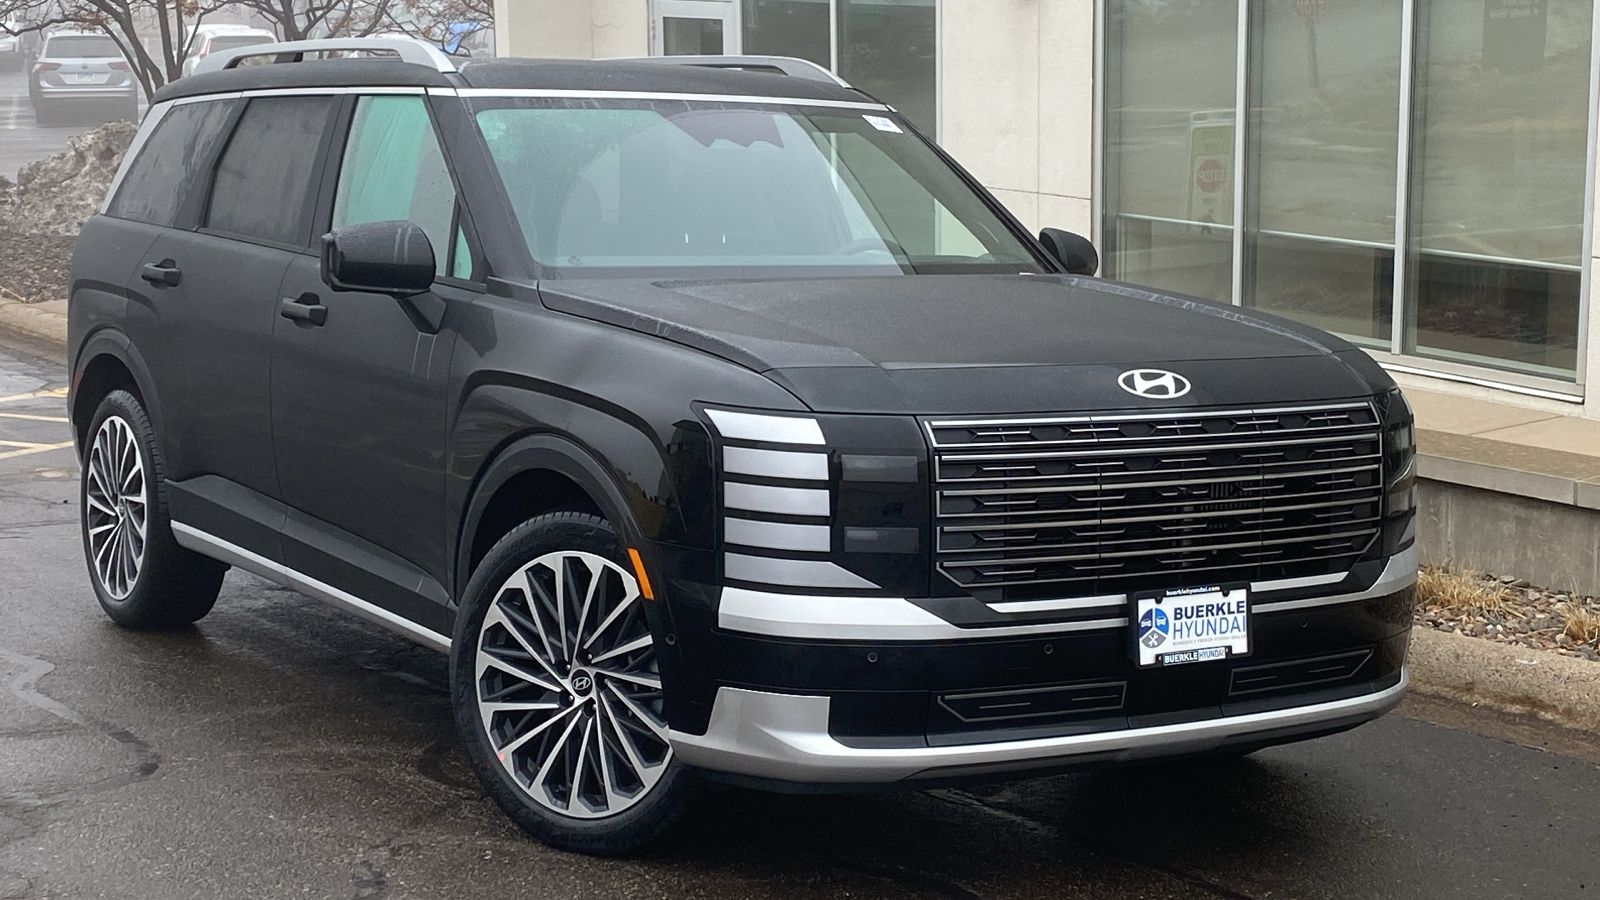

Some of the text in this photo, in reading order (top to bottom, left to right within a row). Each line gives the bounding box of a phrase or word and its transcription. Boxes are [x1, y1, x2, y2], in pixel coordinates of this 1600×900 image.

[1174, 601, 1245, 620] BUERKLE
[1173, 616, 1245, 639] HYUNDAI
[1164, 649, 1224, 664] BUERKLE HYUNDAI
